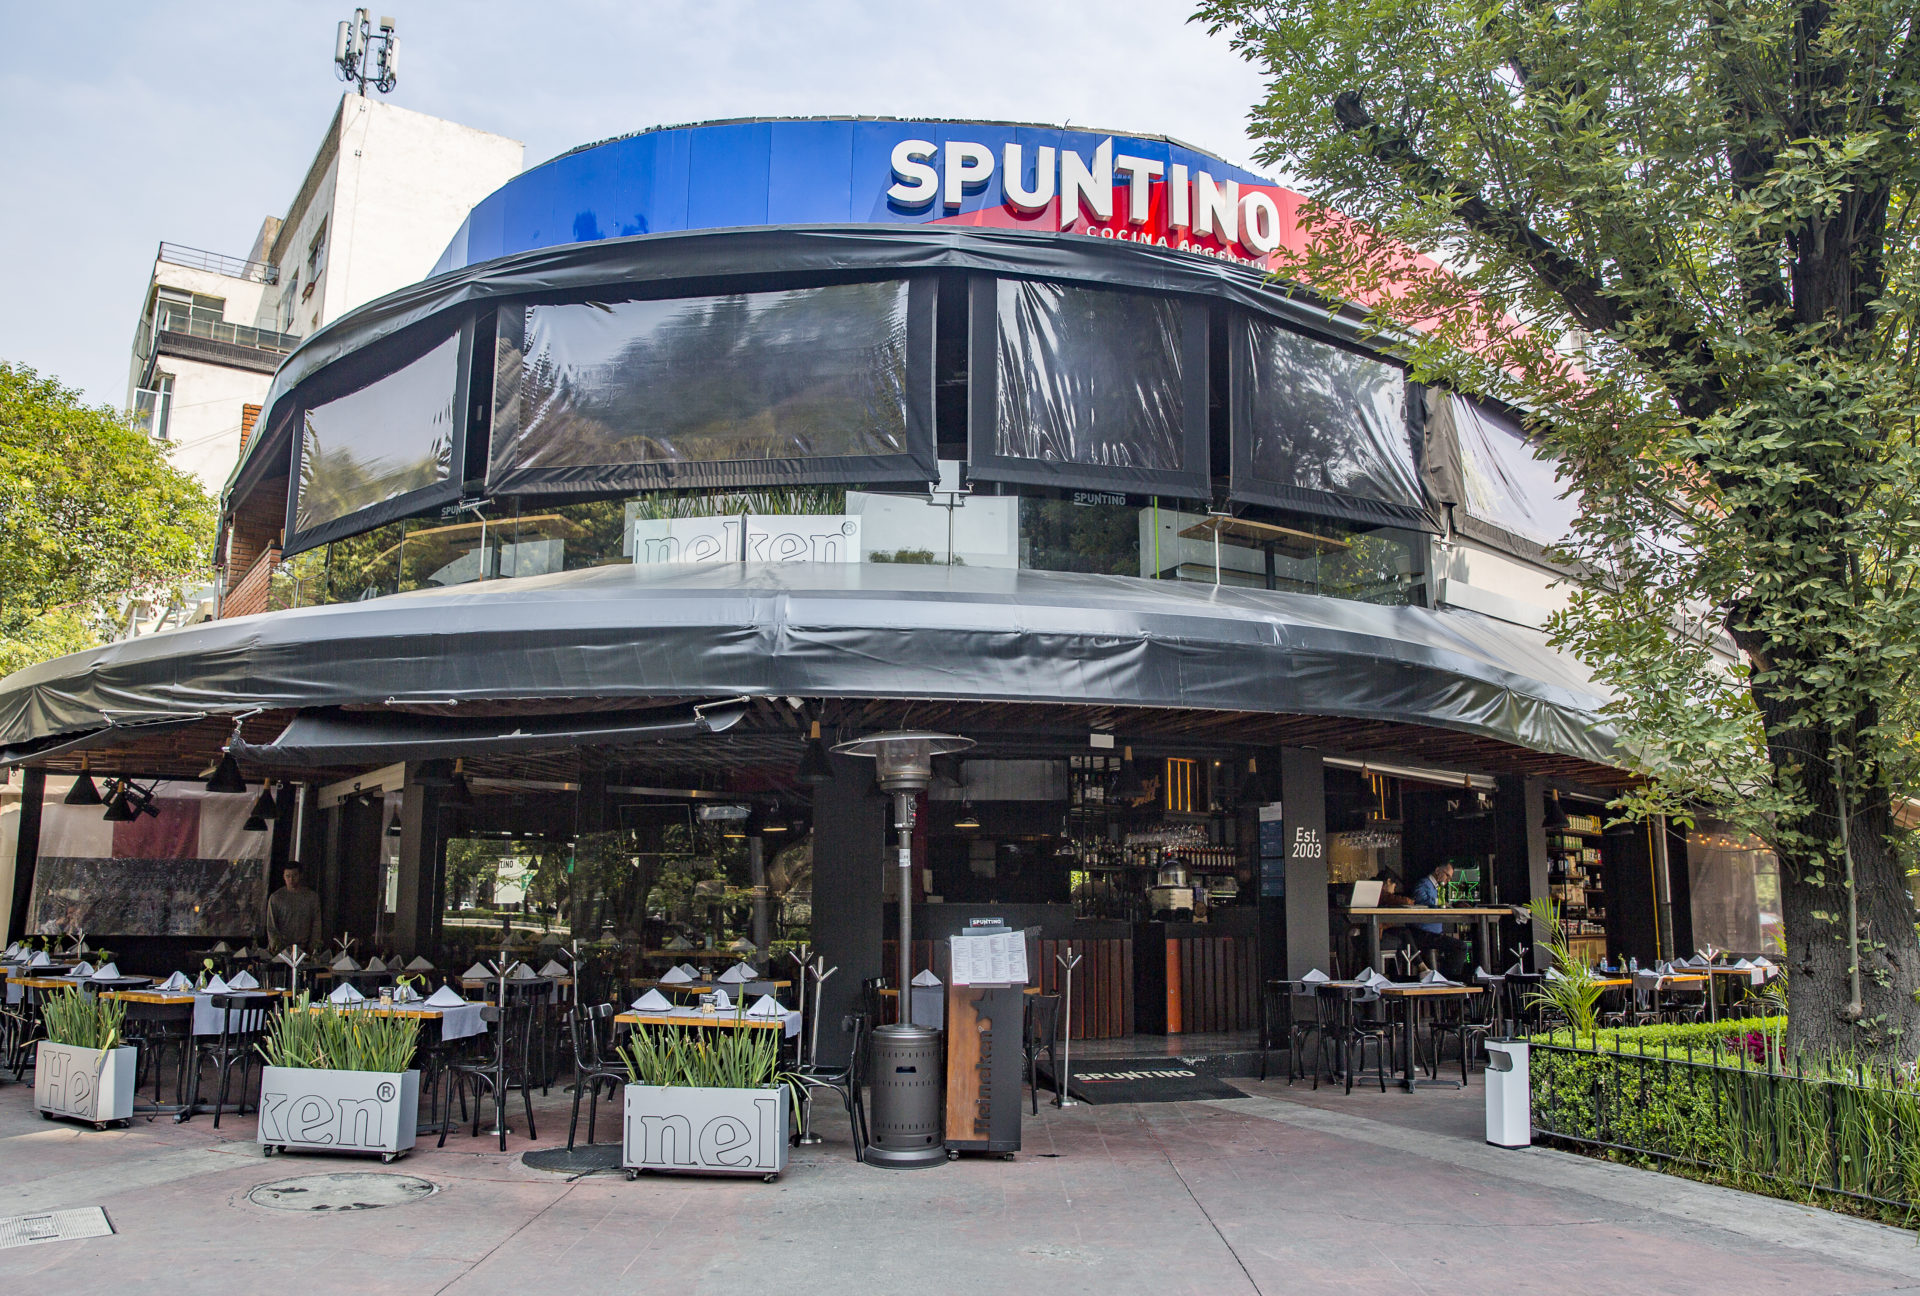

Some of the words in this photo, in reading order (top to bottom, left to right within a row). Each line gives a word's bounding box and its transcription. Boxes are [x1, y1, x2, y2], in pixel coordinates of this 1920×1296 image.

[886, 136, 1281, 255] SPUNTINO
[1086, 225, 1168, 248] COCINA
[1074, 492, 1126, 506] SPUNTINO
[1295, 827, 1320, 842] Est.
[1292, 843, 1322, 858] 2003
[1073, 1070, 1197, 1081] SPUNTINO
[627, 1098, 777, 1168] nel
